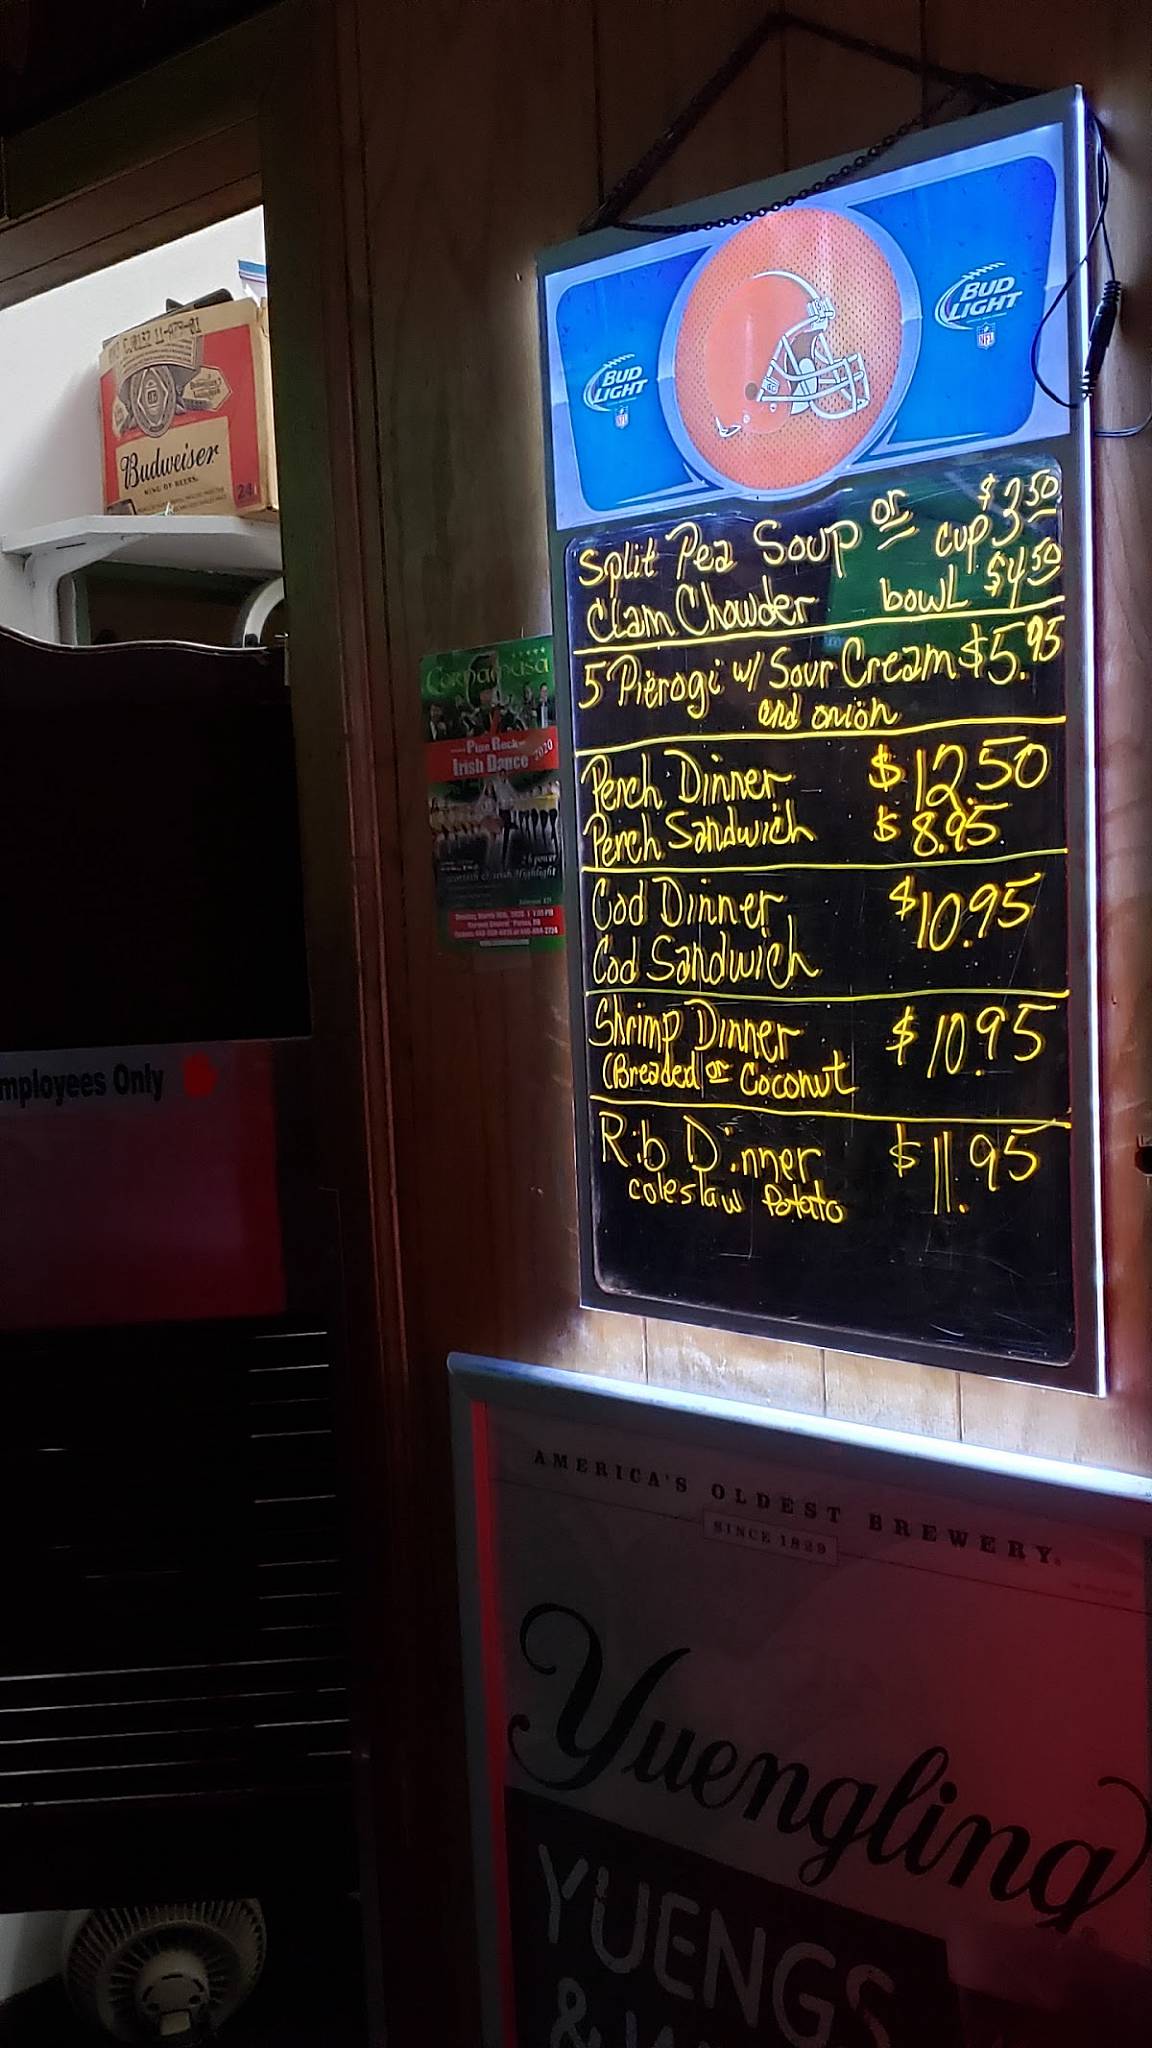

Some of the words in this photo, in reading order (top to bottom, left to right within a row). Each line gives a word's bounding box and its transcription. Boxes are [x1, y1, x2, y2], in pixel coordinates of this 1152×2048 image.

[948, 291, 1023, 321] LIGHT
[960, 277, 1015, 302] BUD
[592, 379, 648, 404] LIGHT
[602, 366, 643, 387] BUD
[120, 443, 220, 490] Budweiser
[163, 481, 173, 491] OF
[236, 483, 255, 501] 24
[579, 535, 657, 586] Split
[666, 523, 734, 581] Pea
[754, 520, 860, 578] Soup
[871, 490, 908, 526] or
[935, 515, 990, 573] cup
[676, 577, 817, 634] Chowder
[579, 663, 606, 708] 5
[607, 655, 721, 718] Pierogi
[734, 653, 762, 692] w/
[769, 651, 836, 688] Sour
[842, 638, 956, 688] Cream
[758, 693, 799, 730] and
[812, 700, 899, 730] onion
[452, 757, 484, 776] Irish
[487, 752, 529, 773] Dance
[581, 754, 661, 817] Perch
[665, 750, 795, 806] Dinner
[583, 814, 662, 868] Perch
[667, 800, 817, 855] Sandwich
[593, 878, 644, 931] Cod
[652, 877, 785, 931] Dinner
[592, 933, 639, 984] Cod
[647, 915, 820, 989] Sandwich
[589, 997, 681, 1052] Shrimp
[684, 999, 801, 1061] Dinner
[113, 1062, 164, 1102] Only
[707, 1059, 730, 1080] or
[739, 1049, 858, 1098] Coconut
[599, 1112, 667, 1171] Rib
[684, 1116, 822, 1184] Dinner
[533, 1448, 688, 1494] AMERICA'S
[711, 1483, 843, 1524] OLDEST
[713, 1520, 771, 1546] SINCE
[780, 1532, 829, 1556] 1829
[508, 1603, 1150, 1933] Yuengling
[538, 1843, 896, 2048] YUENGS
